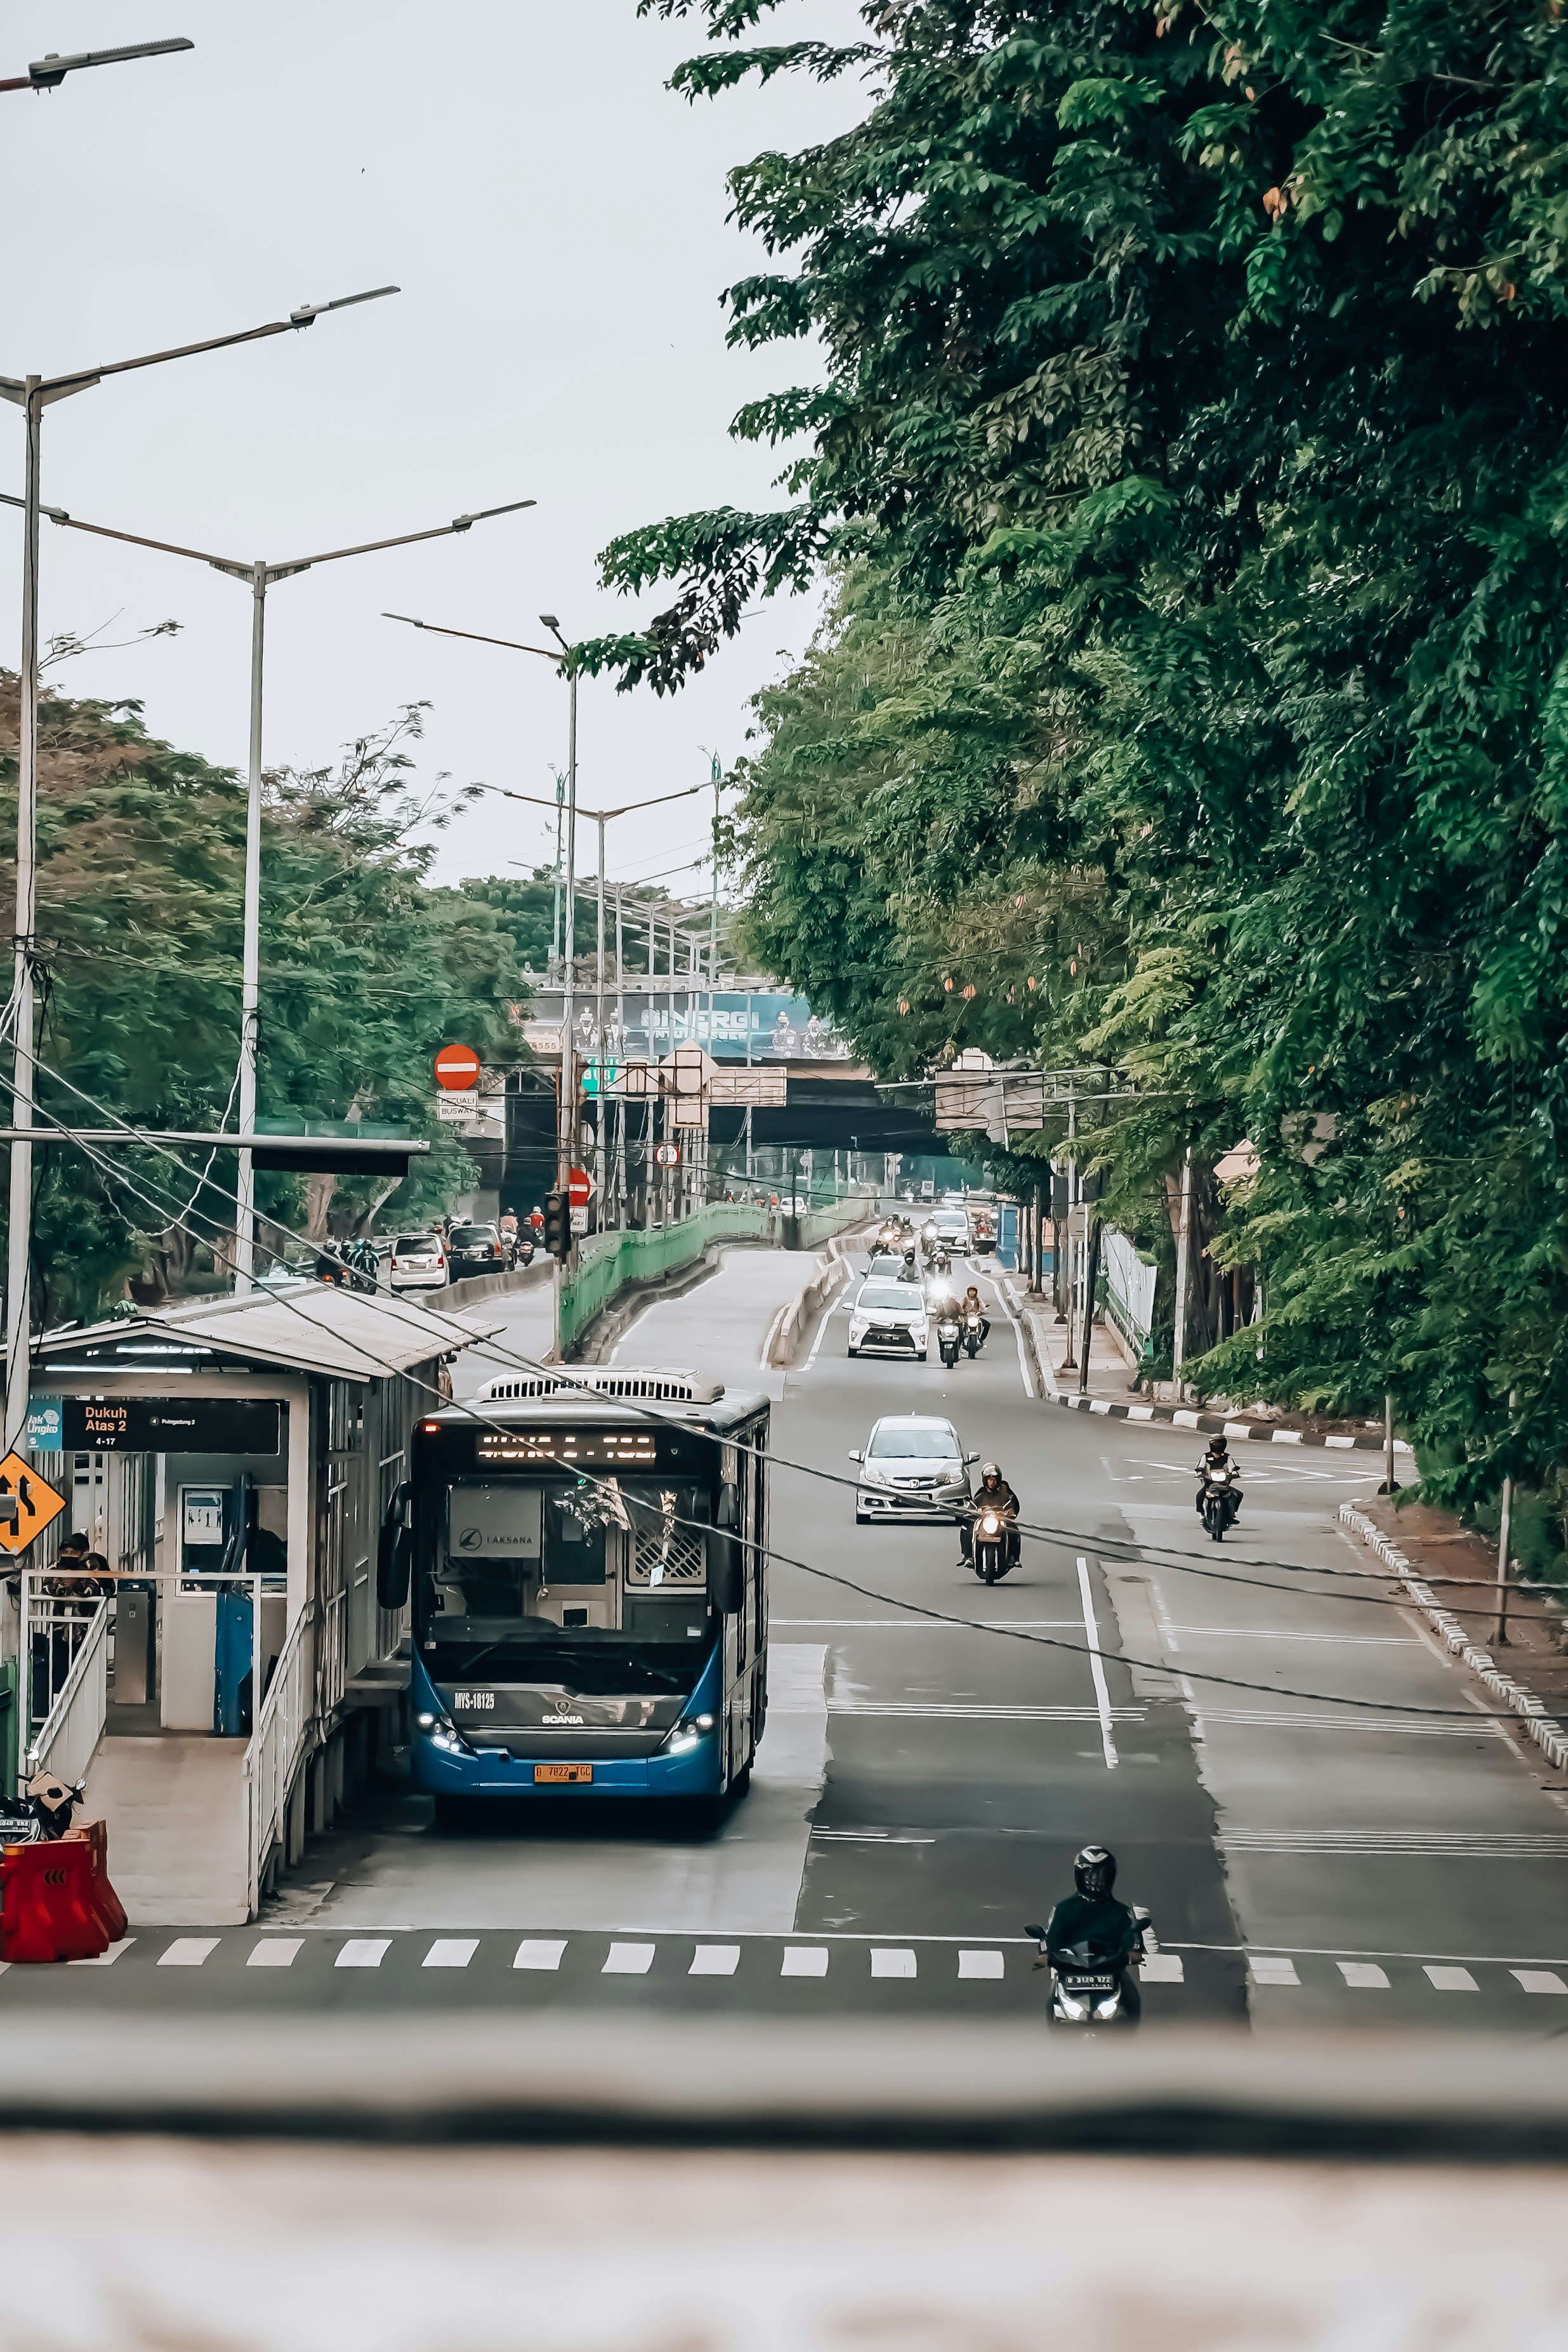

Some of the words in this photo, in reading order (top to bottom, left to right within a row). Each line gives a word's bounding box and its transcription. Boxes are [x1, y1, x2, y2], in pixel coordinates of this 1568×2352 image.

[640, 1010, 760, 1029] SINERGI
[86, 1406, 127, 1418] Dukuh
[86, 1419, 115, 1431] Atas
[118, 1420, 126, 1431] 2
[96, 1437, 116, 1445] 4-17
[487, 1536, 533, 1544] LAKSANA
[454, 1692, 495, 1709] MYS-18125
[541, 1715, 584, 1724] SCANIA
